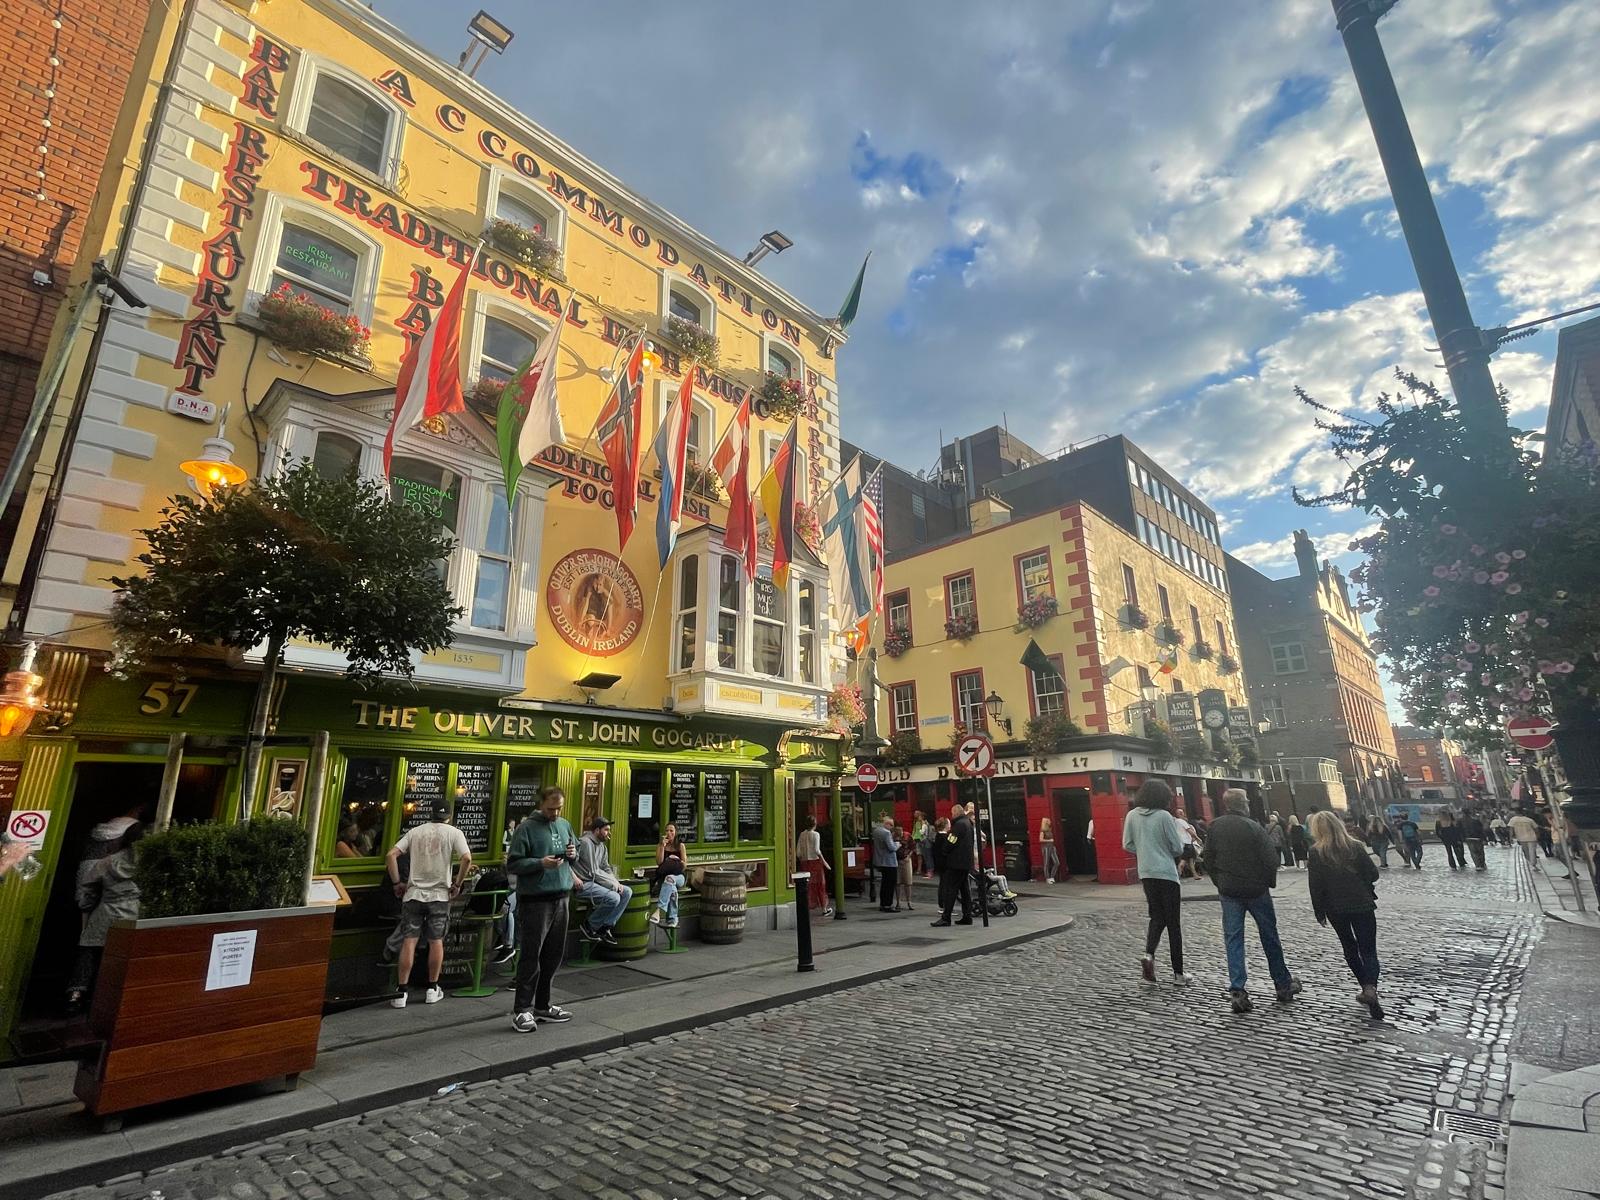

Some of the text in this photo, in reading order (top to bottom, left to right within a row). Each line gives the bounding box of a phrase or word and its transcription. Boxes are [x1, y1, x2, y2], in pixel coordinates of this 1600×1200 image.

[240, 35, 289, 120] BAR
[373, 68, 802, 347] ACCOMMODATION
[174, 122, 270, 396] RESTAURANT
[285, 246, 349, 279] RESTAURANT
[300, 161, 589, 329] TRADITIONAL
[307, 245, 333, 262] IRISH
[806, 369, 820, 424] BAR
[393, 476, 453, 500] TRADITIONAL
[562, 475, 615, 511] FOO
[550, 553, 643, 612] OLIVER ST JOHN GOGARTY
[561, 572, 576, 590] EST
[575, 564, 594, 576] 1835
[551, 604, 637, 651] DUBLIN IRELAND
[140, 681, 199, 716] 57
[1172, 701, 1189, 710] LIVE
[352, 699, 739, 751] THE OLIVER ST. JOHN GOGARTY
[800, 742, 826, 757] BAR
[809, 776, 831, 786] TH
[878, 768, 911, 783] ULD
[1072, 757, 1089, 768] 17
